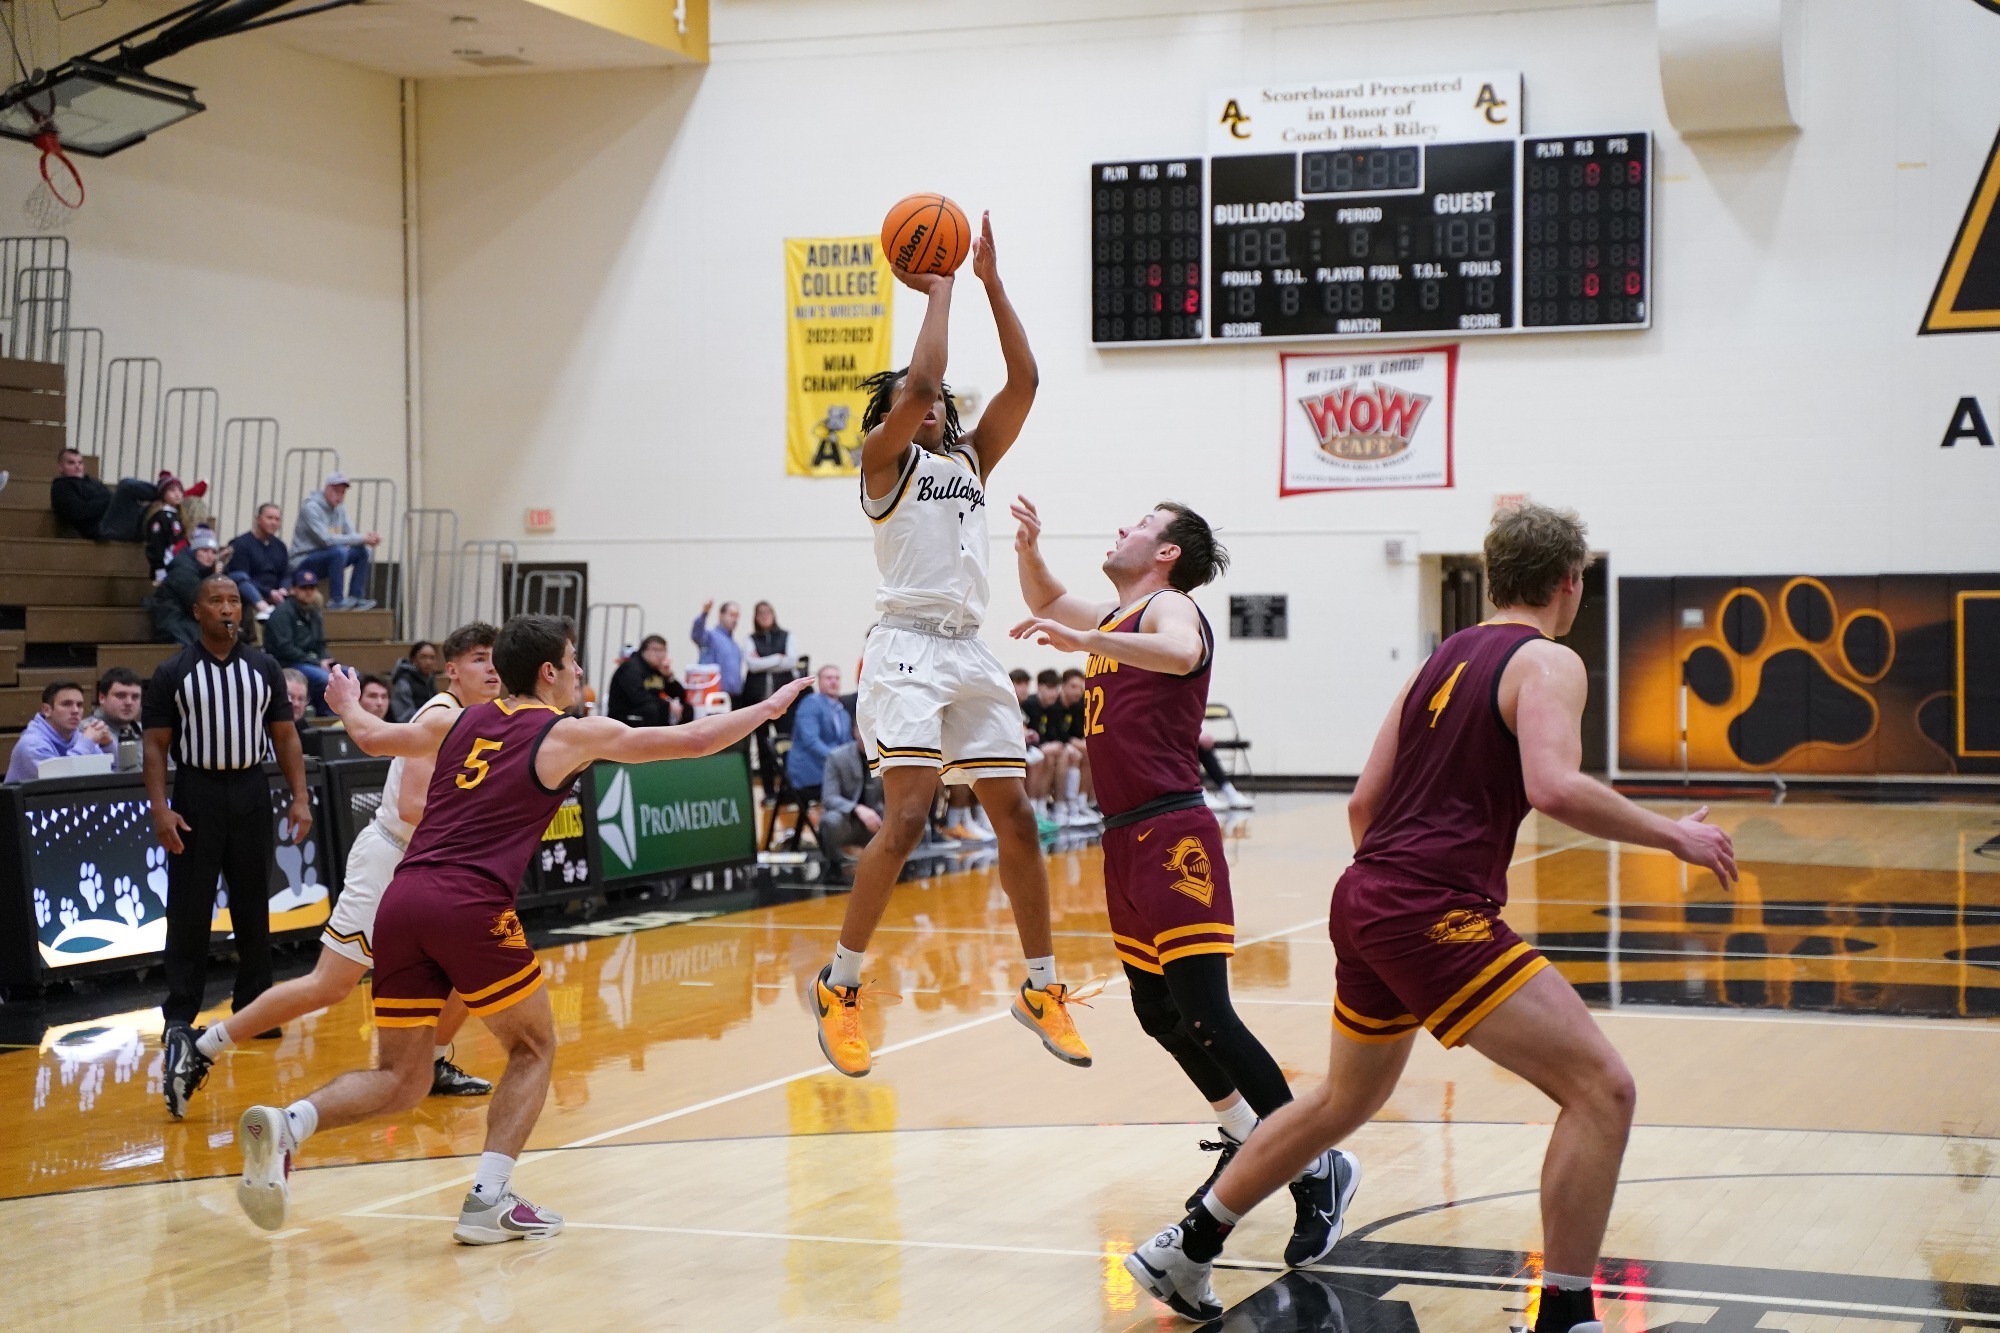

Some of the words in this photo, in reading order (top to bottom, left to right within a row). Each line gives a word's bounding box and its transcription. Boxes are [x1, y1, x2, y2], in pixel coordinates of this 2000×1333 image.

[1262, 83, 1364, 102] Scoreboard
[1371, 77, 1462, 97] Presented
[1308, 106, 1326, 121] in
[1331, 103, 1391, 120] Honor
[1396, 100, 1416, 117] of
[1281, 128, 1338, 143] Coach
[1342, 125, 1388, 140] Buck
[1392, 122, 1441, 139] Riley
[1536, 141, 1564, 158] PLYR
[1607, 138, 1628, 155] PTS
[1102, 166, 1128, 182] PLYR
[1166, 163, 1187, 179] PTS
[1213, 201, 1305, 226] BULLDOGS
[1433, 191, 1495, 215] GUEST
[1336, 207, 1383, 224] PERIOD
[807, 243, 873, 267] ADRIAN
[802, 271, 878, 297] COLLEGE
[1221, 270, 1262, 287] FOULS
[1316, 266, 1364, 283] PLAYER
[1369, 265, 1402, 280] FOUL
[1459, 260, 1501, 277] FOULS
[1221, 321, 1262, 337] SCORE
[1336, 318, 1381, 334] MATCH
[1460, 313, 1502, 329] SCORE
[1299, 380, 1433, 446] WOW
[1428, 660, 1468, 728] 4
[455, 738, 503, 790] 5
